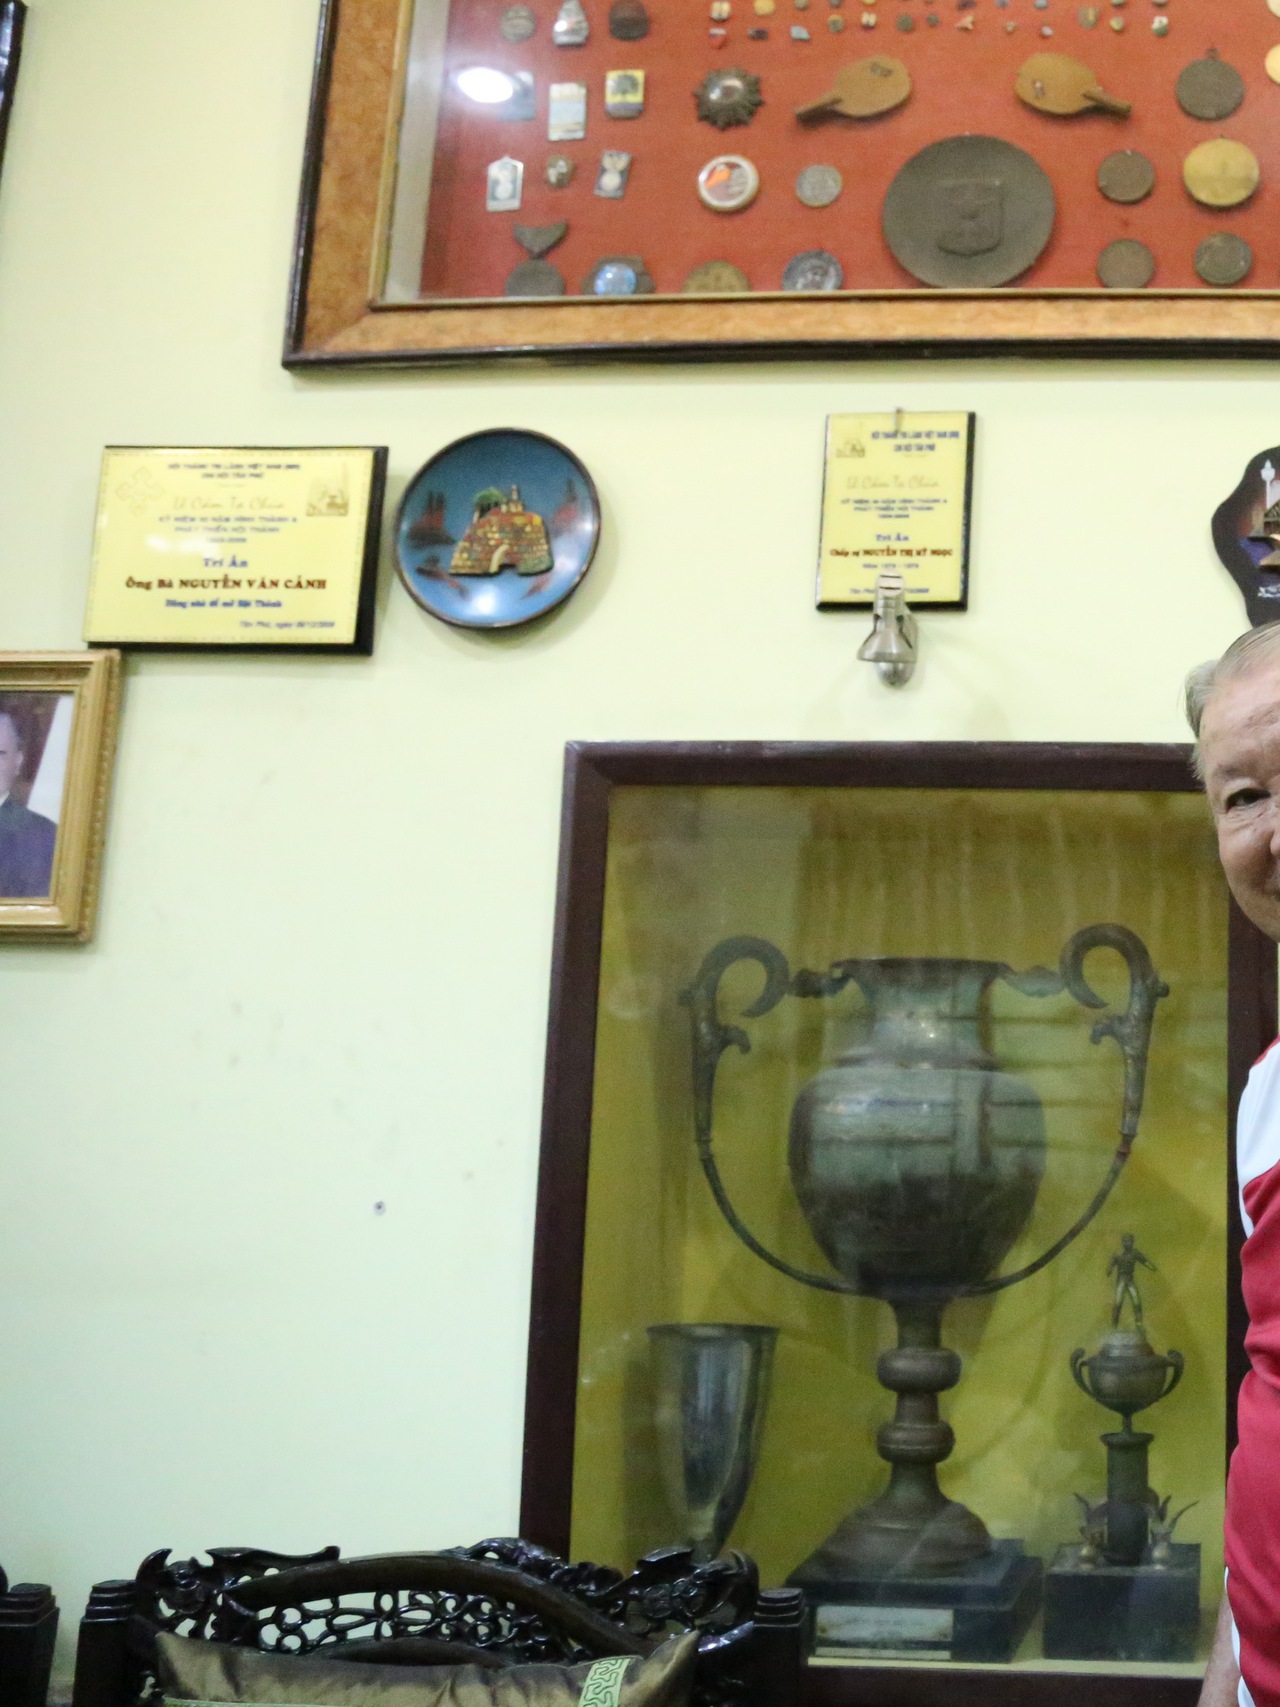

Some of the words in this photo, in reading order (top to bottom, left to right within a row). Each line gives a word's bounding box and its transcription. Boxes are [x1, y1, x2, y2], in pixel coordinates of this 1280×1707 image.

[203, 558, 224, 568] Tri
[125, 576, 152, 590] Ông
[179, 574, 241, 589] NGUYỄN
